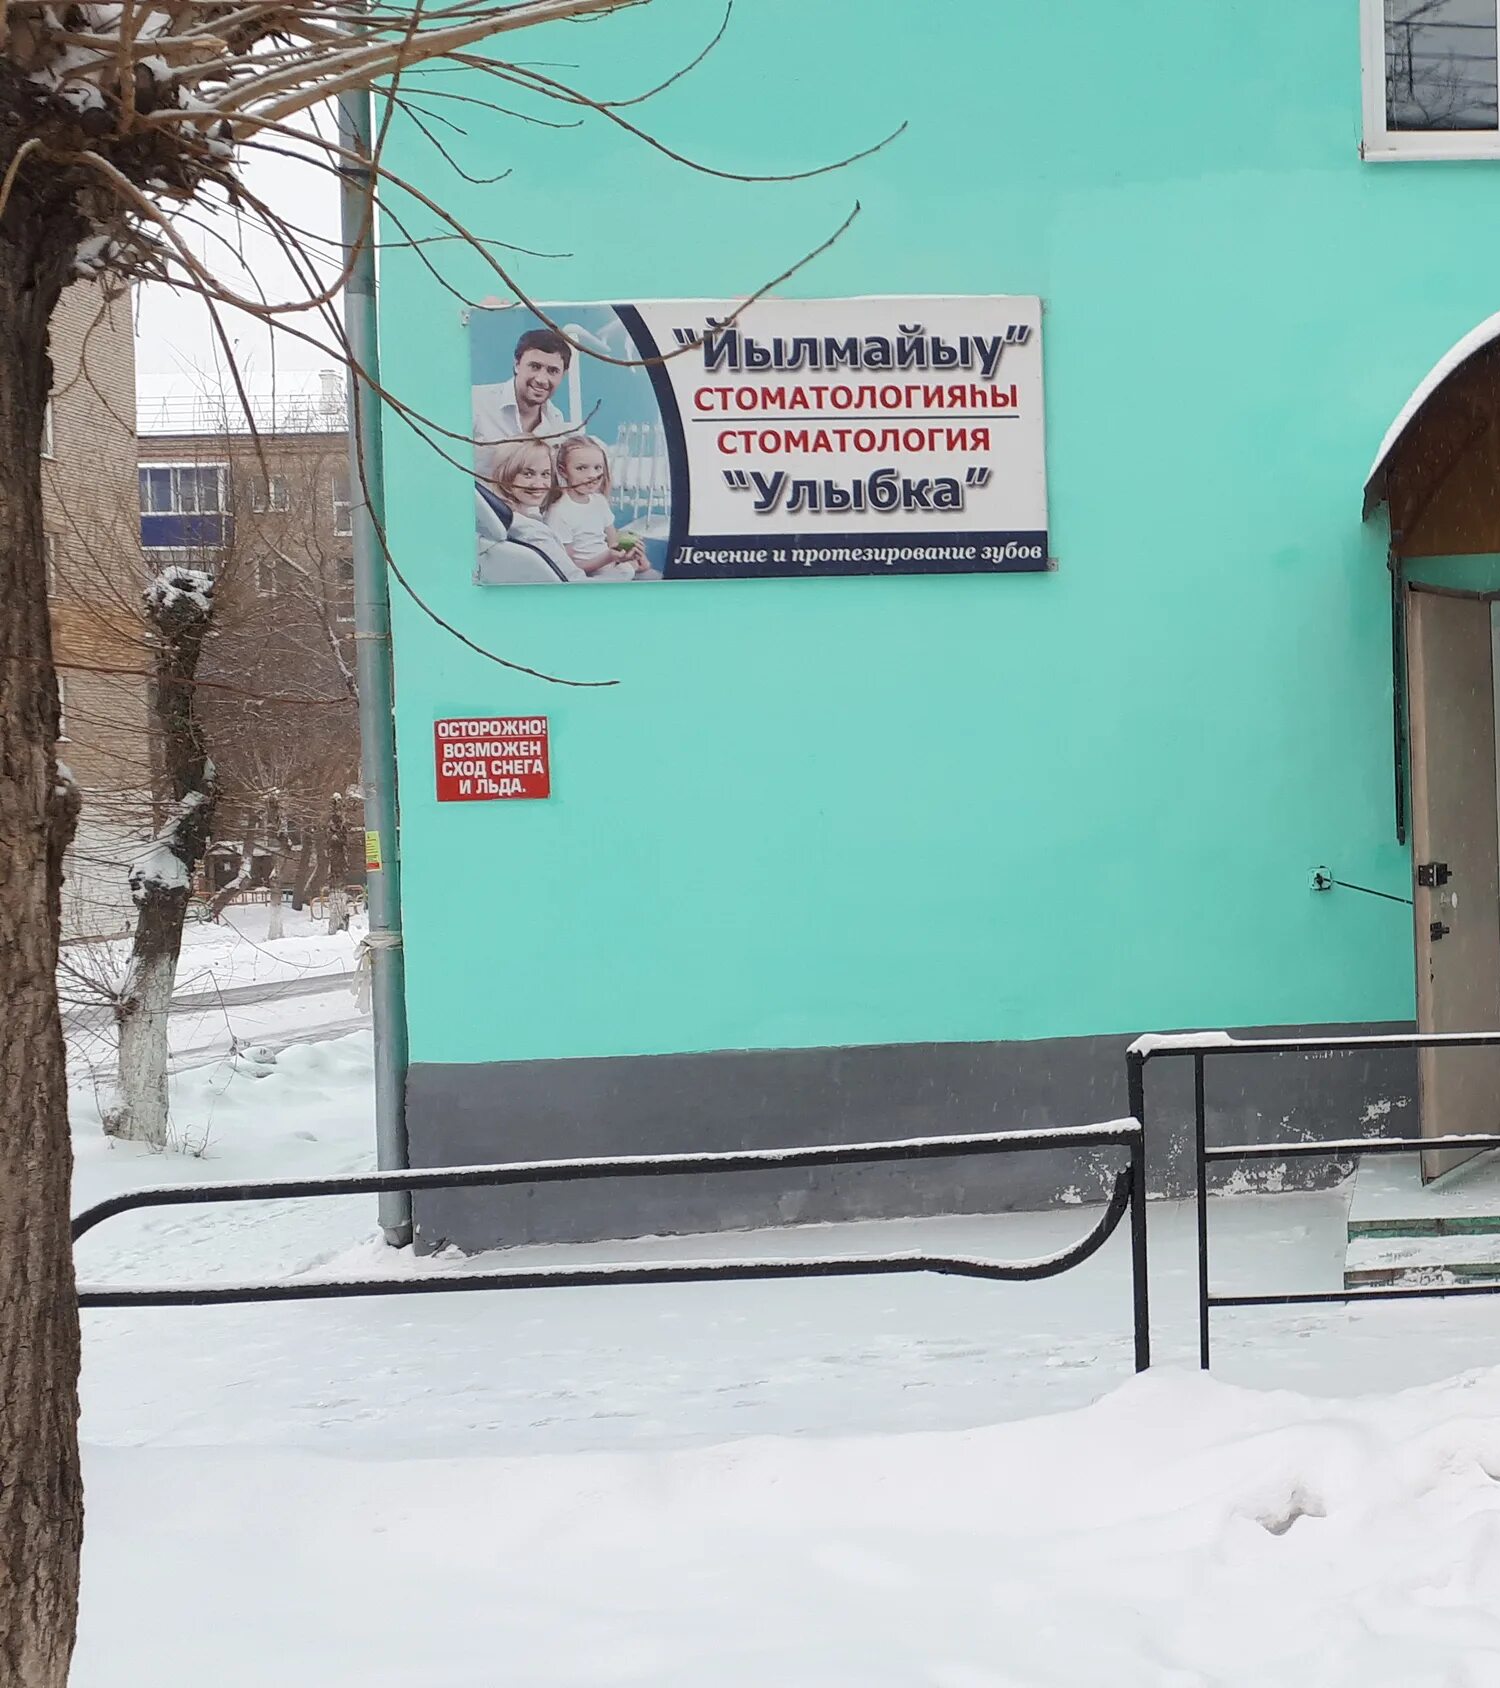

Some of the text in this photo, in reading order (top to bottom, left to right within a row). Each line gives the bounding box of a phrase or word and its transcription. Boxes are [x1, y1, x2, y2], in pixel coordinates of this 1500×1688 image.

[671, 316, 1031, 377] "Йылмайыу"
[717, 428, 990, 454] СТОМАТОЛОГИЯ
[722, 467, 990, 512] "Улыбка"
[674, 541, 1042, 567] Лечение и протезирование зубов
[437, 719, 546, 737] ОСТОРОЖНО!
[443, 740, 541, 758] ВОЗМОЖЕН
[442, 758, 544, 778] СХОД СНЕГА
[459, 777, 526, 796] И ЛЬДА.
